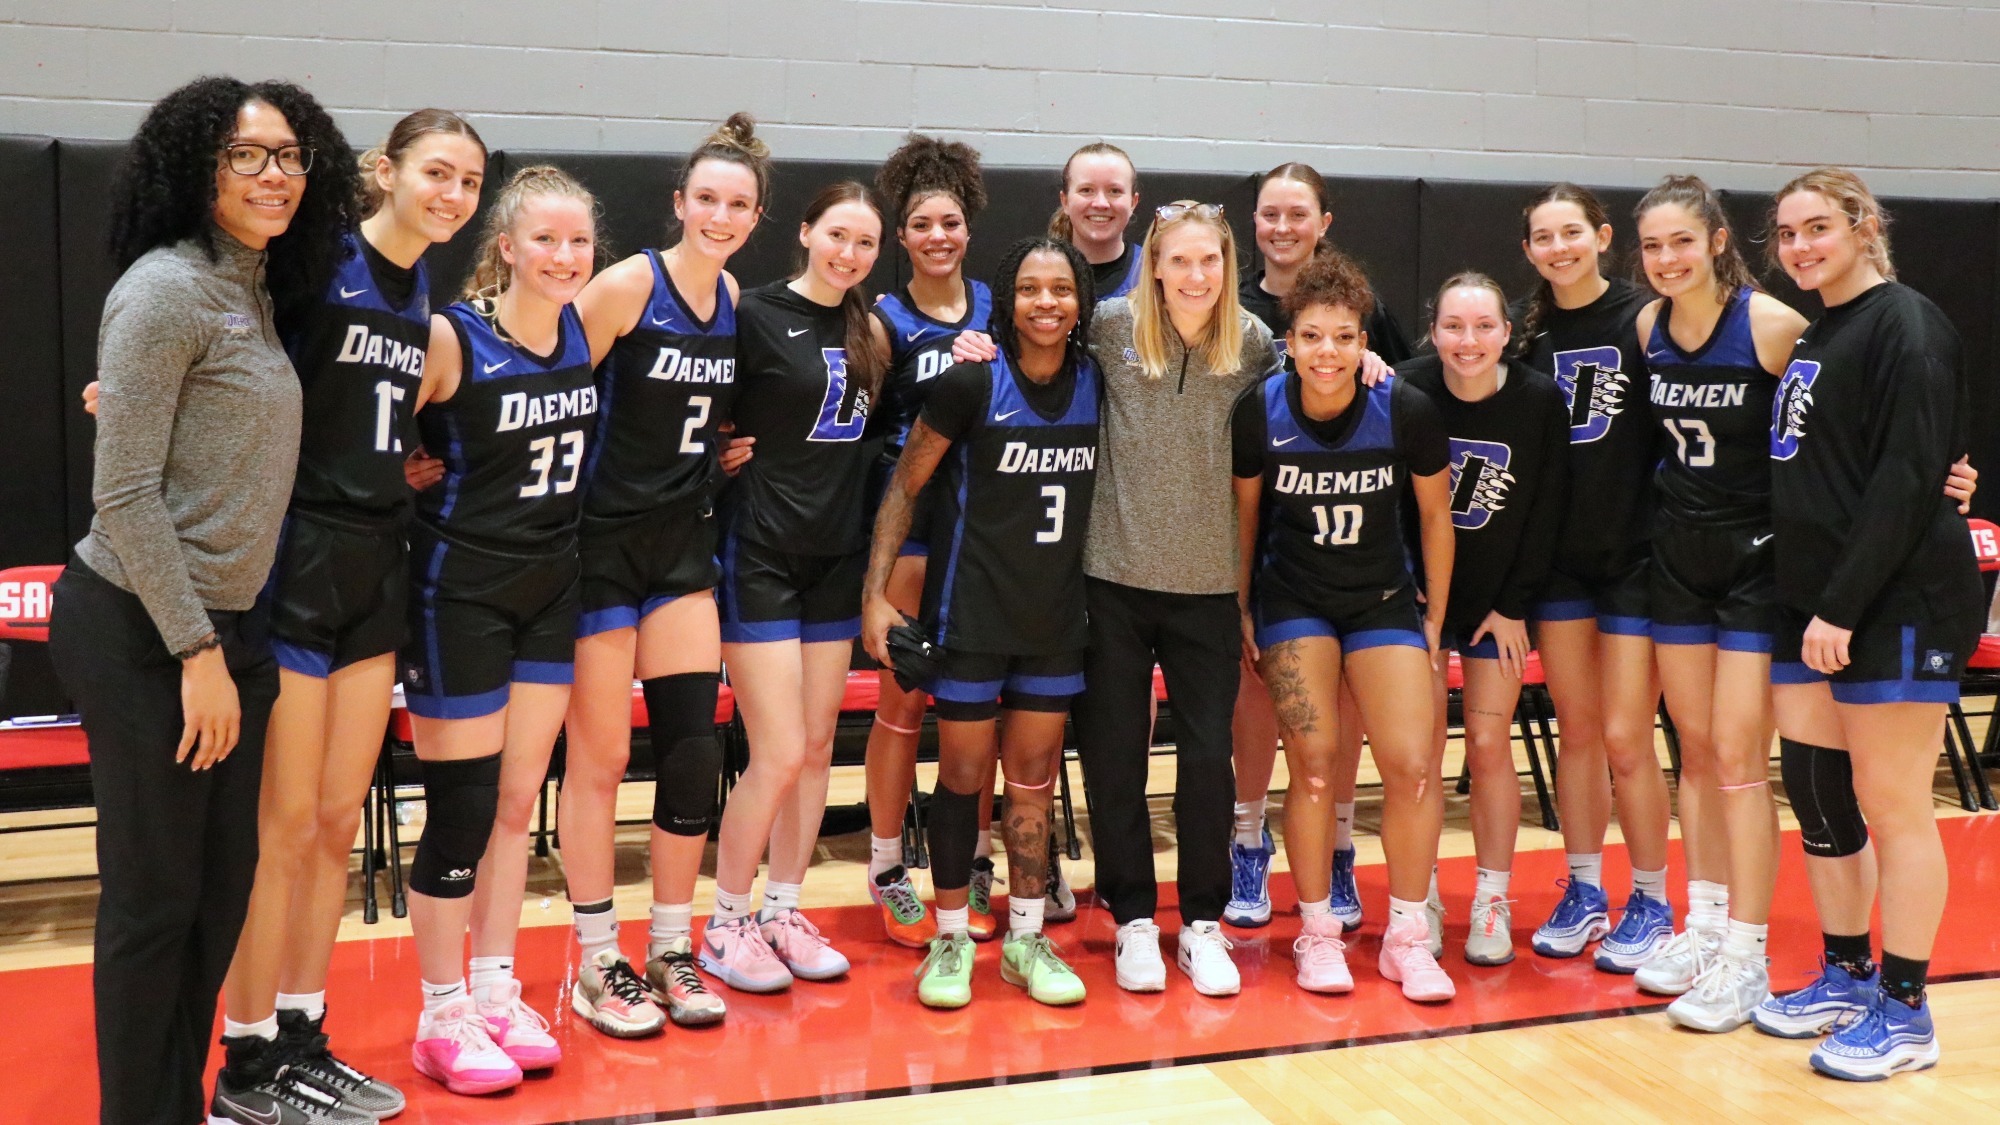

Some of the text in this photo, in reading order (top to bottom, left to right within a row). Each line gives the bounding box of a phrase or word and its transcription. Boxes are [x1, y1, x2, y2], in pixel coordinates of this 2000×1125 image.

[336, 325, 425, 378] DAME
[679, 395, 713, 453] 2
[1663, 418, 1716, 467] 13
[518, 429, 585, 498] 33
[996, 441, 1097, 474] DAEMEN
[1274, 464, 1395, 495] DAEMEN
[1036, 485, 1067, 543] 3
[1311, 504, 1363, 546] 10
